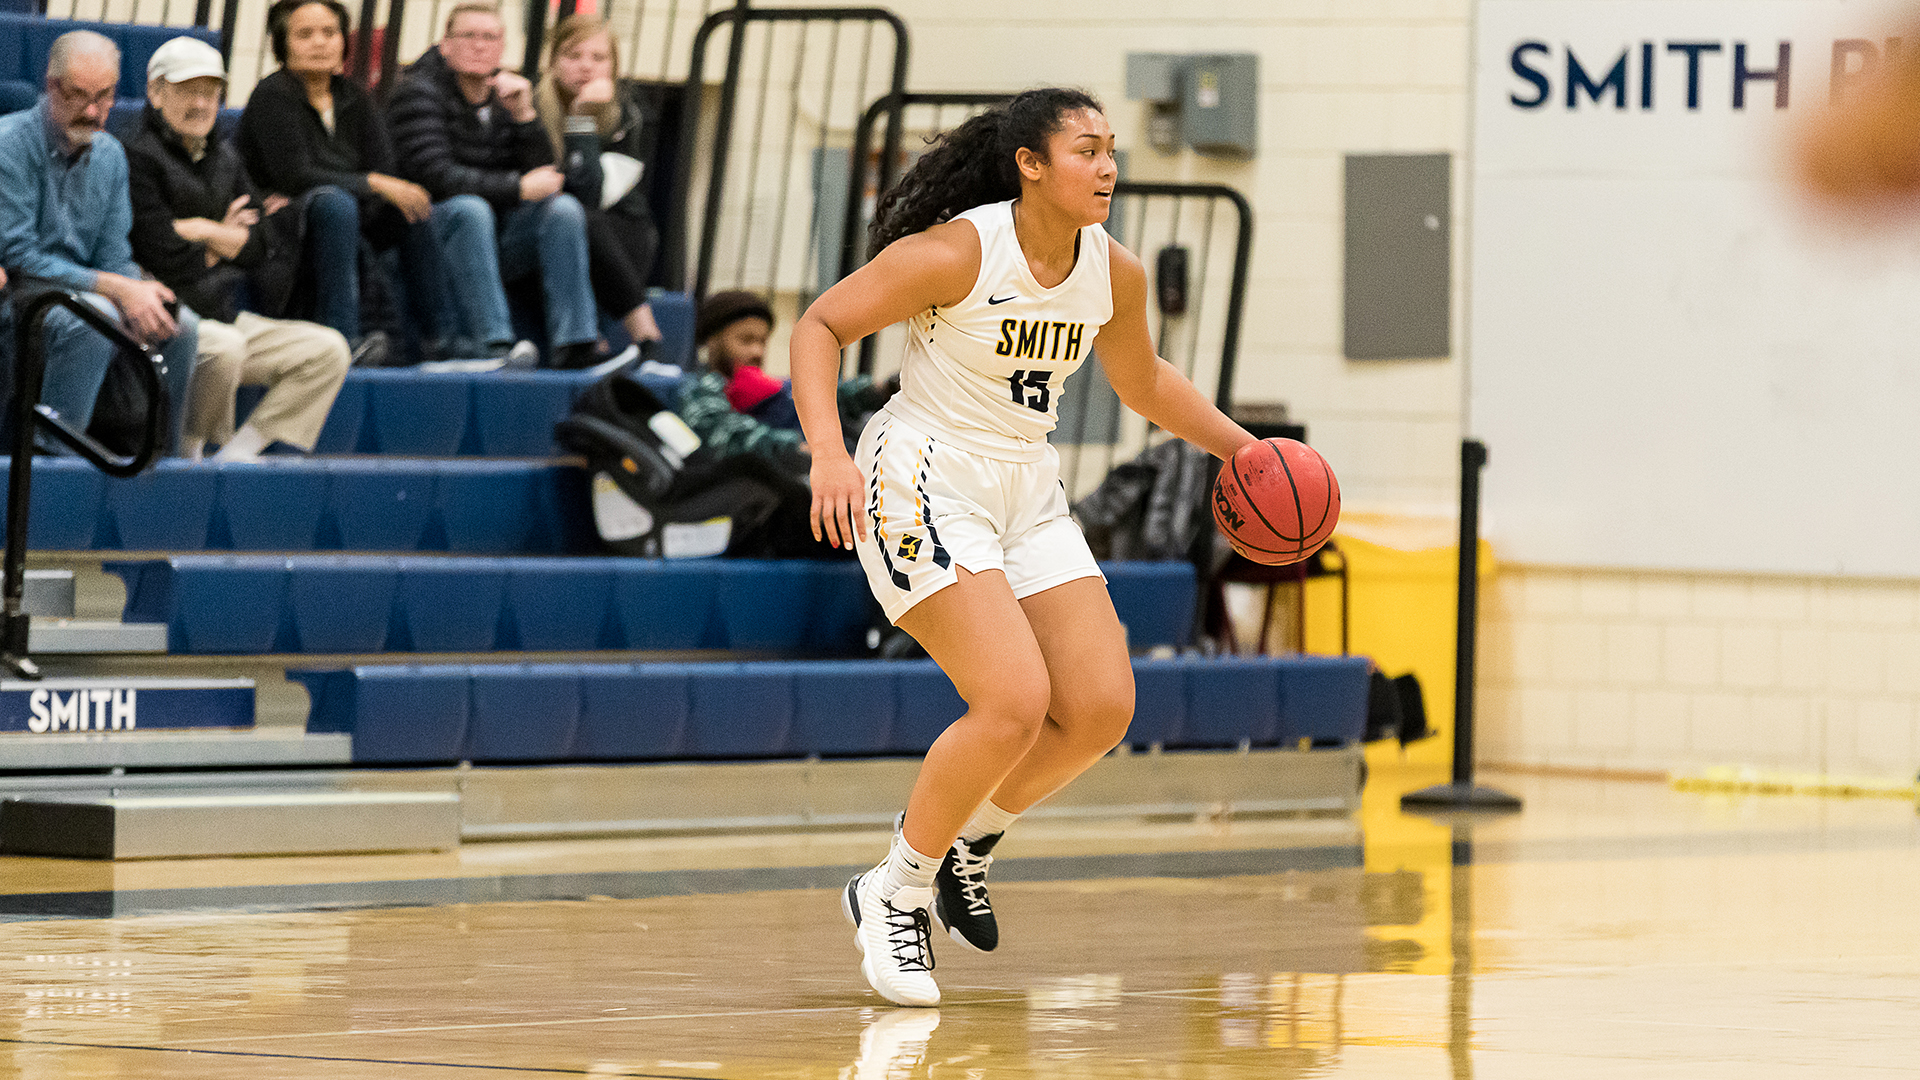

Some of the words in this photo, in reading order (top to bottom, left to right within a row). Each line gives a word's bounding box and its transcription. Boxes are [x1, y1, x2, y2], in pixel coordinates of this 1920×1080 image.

[1509, 41, 1792, 110] SMITH
[994, 318, 1085, 361] SMITH
[1007, 369, 1054, 413] 15
[28, 688, 137, 733] SMITH
